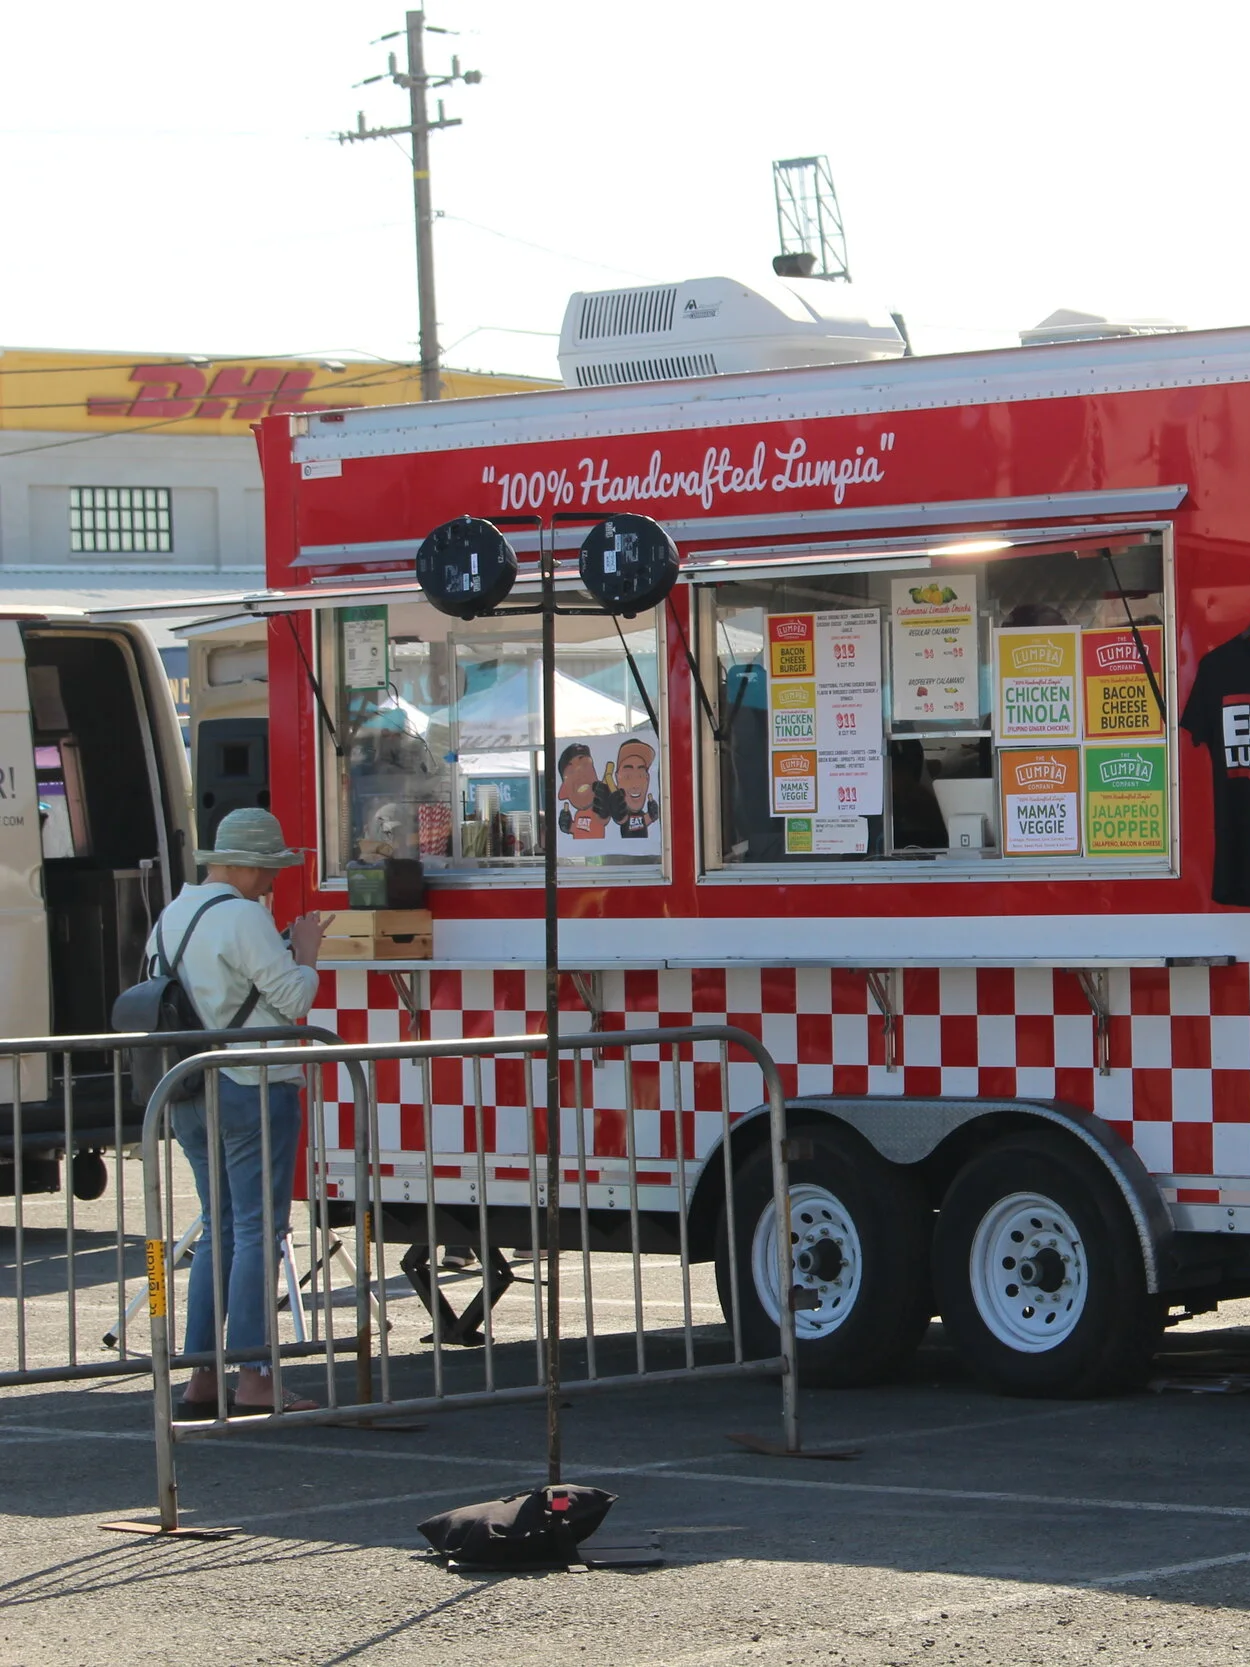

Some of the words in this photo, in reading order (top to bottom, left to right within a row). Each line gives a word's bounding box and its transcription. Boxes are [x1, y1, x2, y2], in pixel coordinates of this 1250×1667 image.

[127, 365, 322, 420] DHL
[481, 464, 574, 511] "100%
[578, 441, 767, 510] Handcrafted
[772, 432, 896, 505] Lumpia"
[780, 647, 805, 656] BACON
[1015, 648, 1060, 665] LUMPIA
[780, 656, 806, 664] CHEESE
[779, 664, 807, 672] BURGER
[1005, 686, 1070, 703] CHICKEN
[1103, 685, 1146, 700] BACON
[1005, 703, 1071, 724] TINOLA
[1102, 700, 1148, 715] CHEESE
[774, 714, 813, 725] CHICKEN
[1101, 714, 1150, 730] BURGER
[775, 725, 814, 737] TINOLA
[1018, 765, 1063, 783] LUMPIA
[1103, 763, 1149, 779] LUMPIA
[780, 782, 809, 791] MAMA'S
[781, 791, 808, 801] VEGGIE
[1017, 803, 1067, 819] MAMA'S
[1092, 801, 1160, 819] JALAPEÑO
[577, 817, 592, 827] EAT
[629, 816, 644, 827] EAT
[1019, 820, 1065, 834] VEGGIE
[1092, 820, 1161, 839] POPPER
